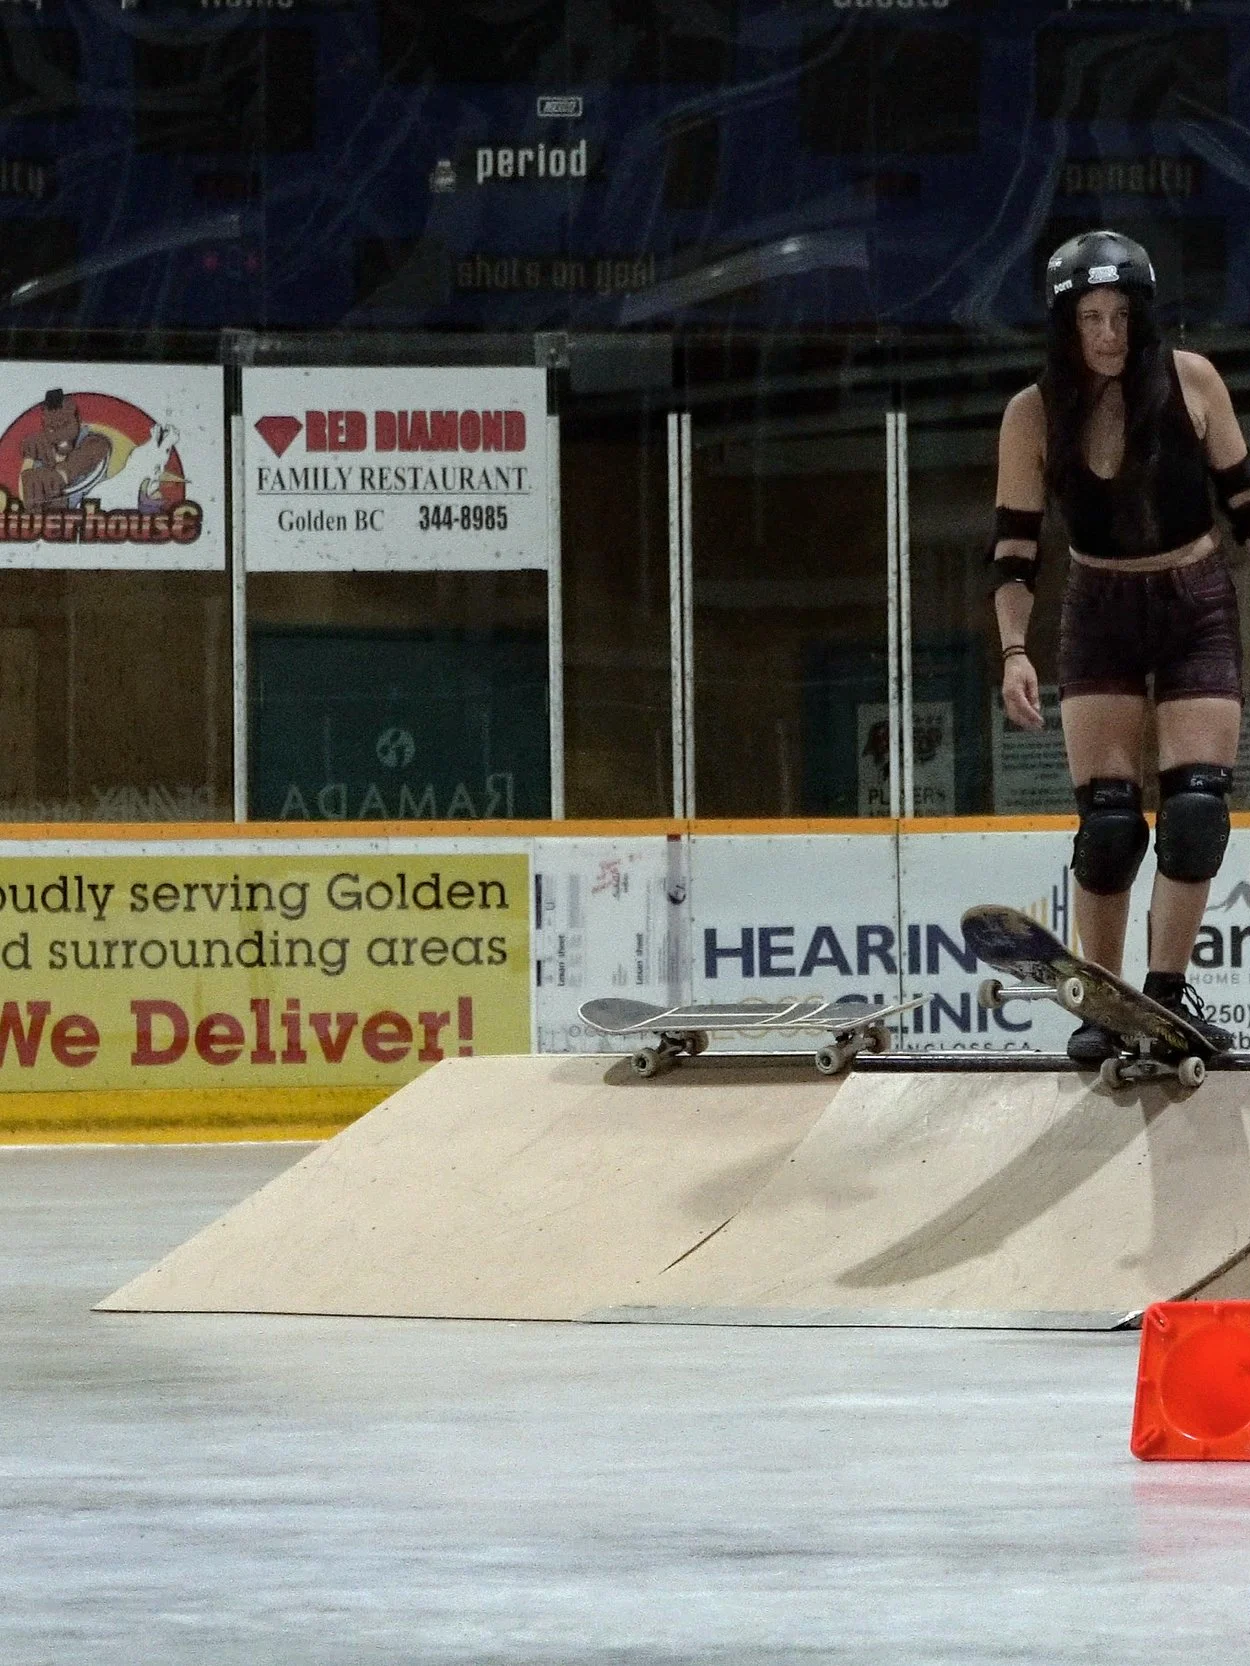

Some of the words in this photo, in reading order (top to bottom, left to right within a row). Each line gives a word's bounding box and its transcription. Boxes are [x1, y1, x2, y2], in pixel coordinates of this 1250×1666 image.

[477, 138, 588, 185] period
[305, 410, 368, 452] RED
[375, 410, 527, 452] DIAMOND
[257, 466, 352, 492] FAMILY
[360, 466, 529, 492] RESTAURANT
[0, 495, 203, 544] iverhouse
[277, 509, 348, 532] Golden
[354, 509, 385, 532] BC
[419, 505, 508, 531] 344-8985
[129, 874, 309, 920] serving
[328, 872, 510, 913] Golden
[49, 930, 350, 977] surrounding
[367, 935, 509, 967] areas
[704, 924, 978, 980] HEARIN
[0, 1000, 100, 1068] We
[131, 995, 475, 1068] Deliver!
[836, 991, 1033, 1035] LINIC
